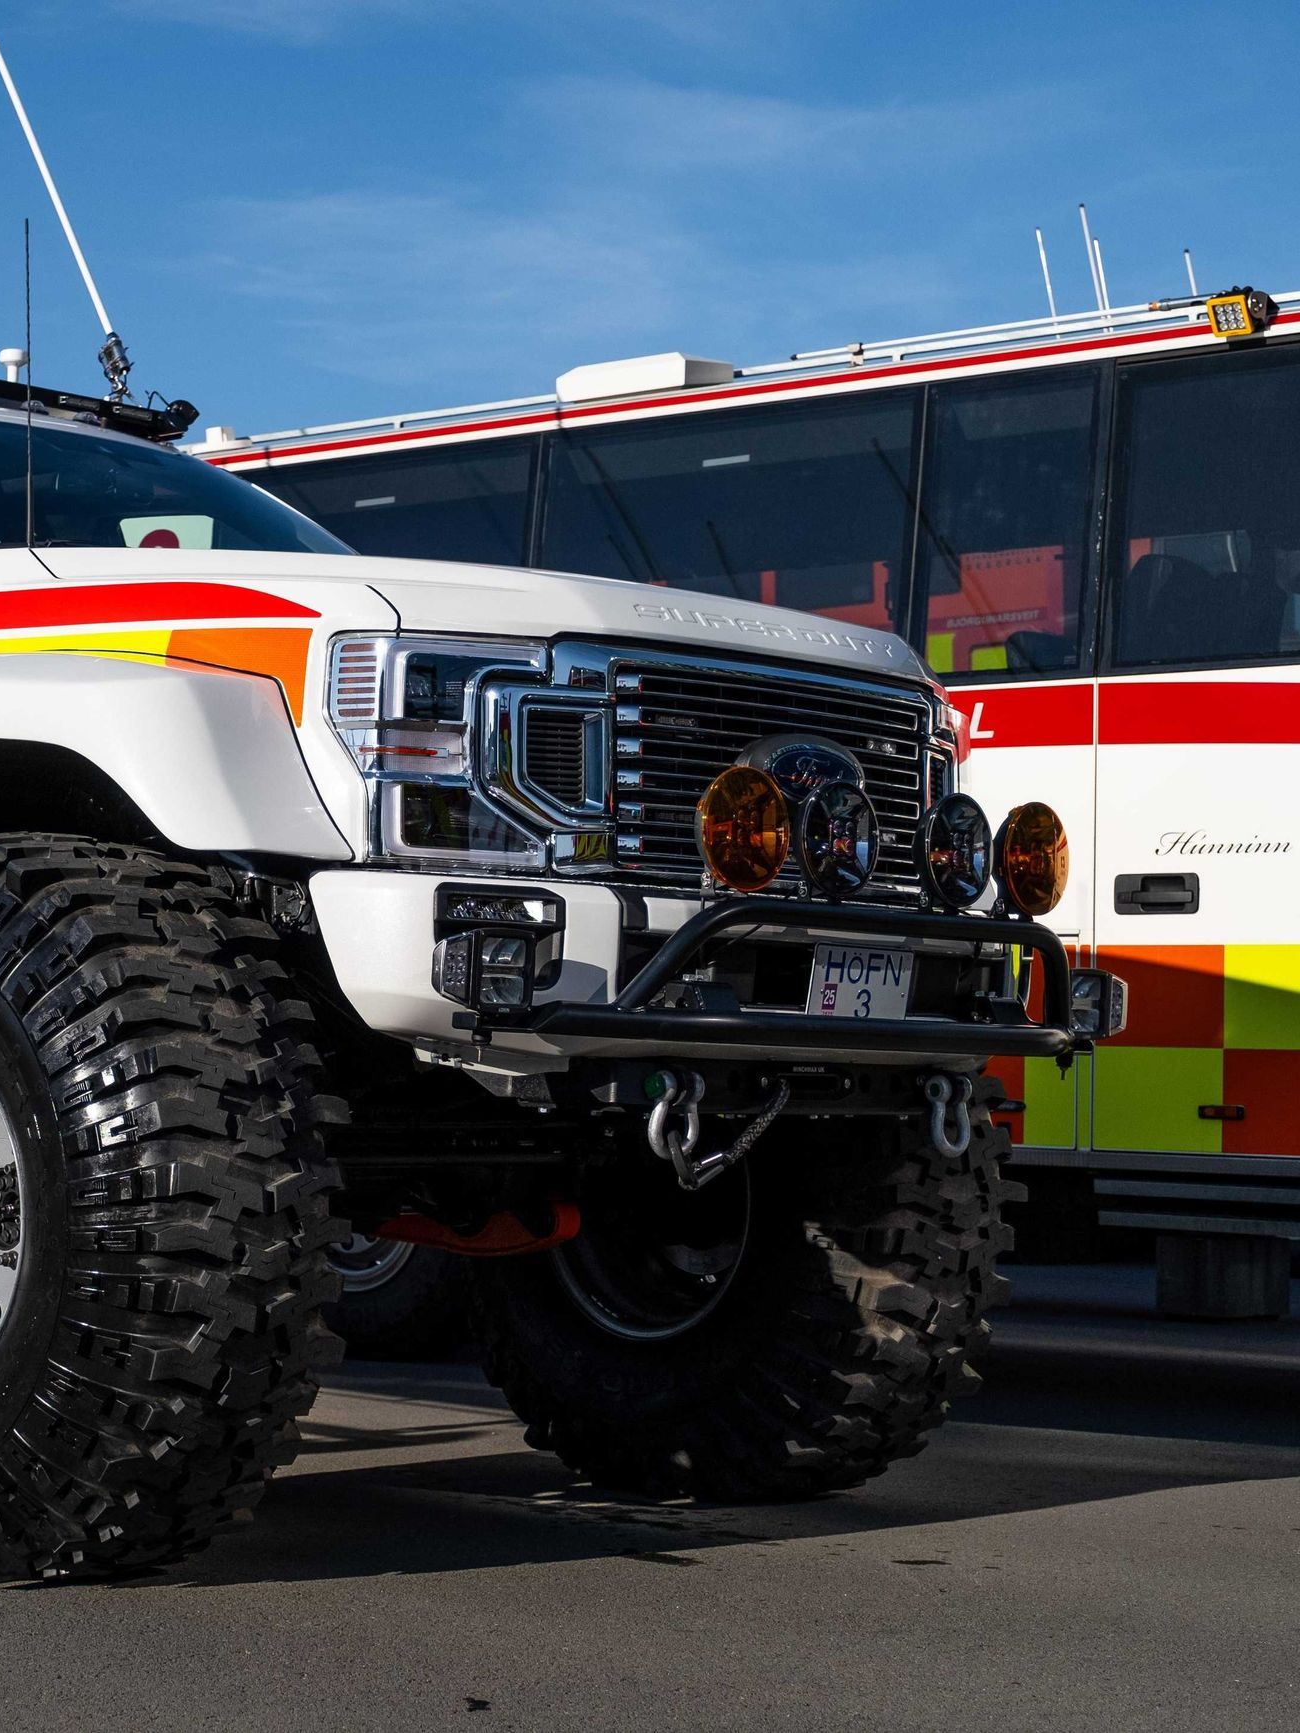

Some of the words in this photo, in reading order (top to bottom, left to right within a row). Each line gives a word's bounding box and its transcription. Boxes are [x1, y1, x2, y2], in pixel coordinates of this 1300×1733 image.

[633, 602, 796, 641] SUPER
[824, 949, 904, 987] HÖFN
[822, 989, 836, 1006] 25
[854, 988, 872, 1019] 3
